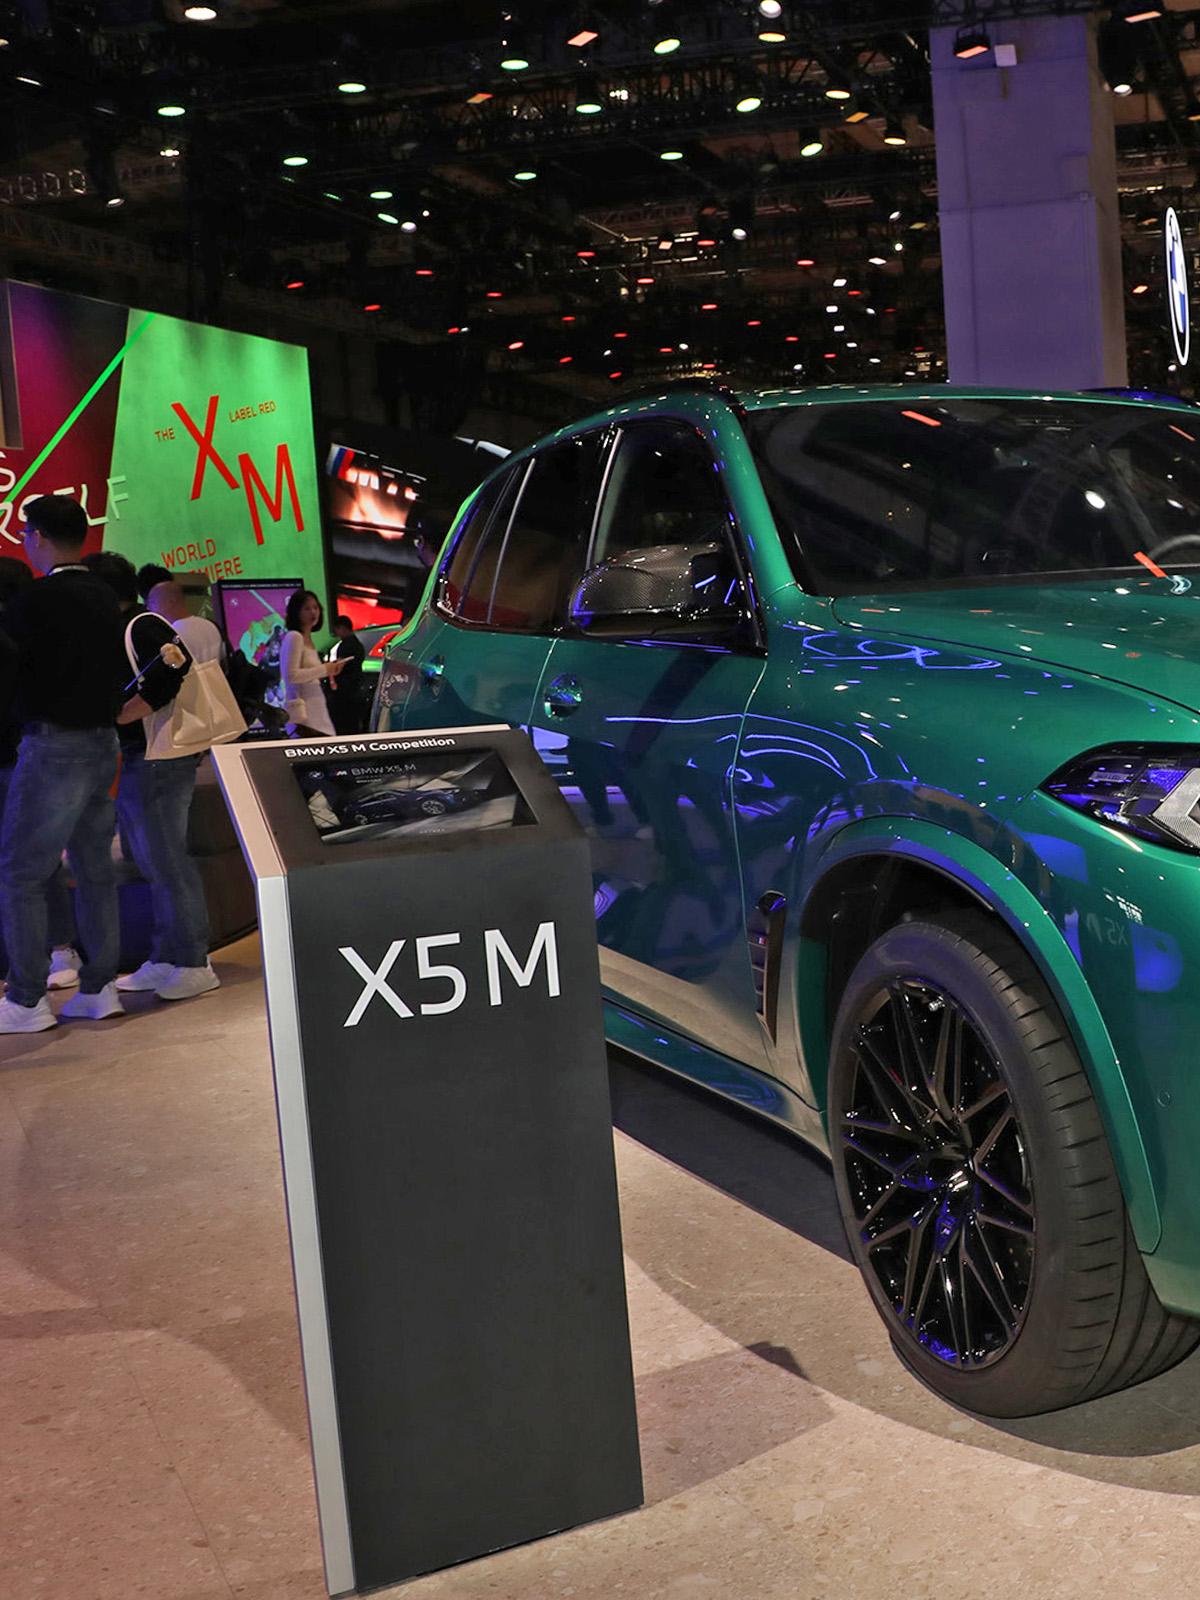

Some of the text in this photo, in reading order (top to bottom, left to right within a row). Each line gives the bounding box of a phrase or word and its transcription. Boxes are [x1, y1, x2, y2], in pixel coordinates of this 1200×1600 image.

[155, 428, 175, 442] THE
[229, 405, 257, 422] LABEL
[258, 400, 276, 415] RED
[161, 538, 217, 569] WORLD
[285, 738, 456, 758] BMW X5 M Competition
[351, 767, 384, 776] BMW
[338, 921, 561, 1027] X5 M
